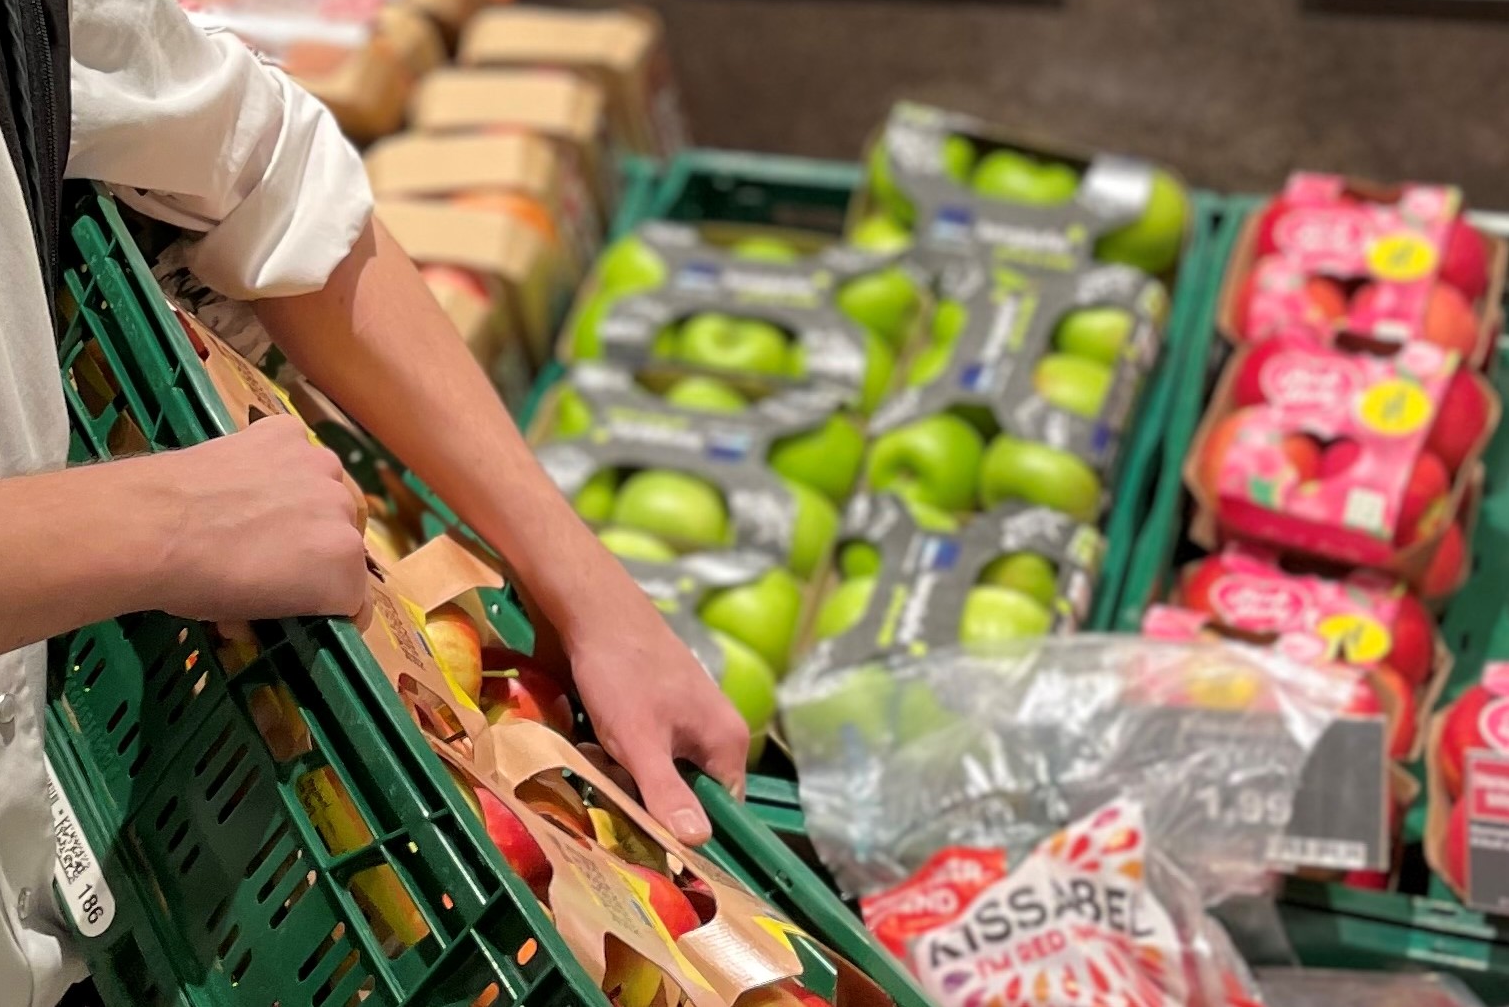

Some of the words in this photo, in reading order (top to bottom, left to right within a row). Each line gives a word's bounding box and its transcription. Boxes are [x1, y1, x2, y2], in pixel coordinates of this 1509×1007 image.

[77, 883, 104, 925] 186
[929, 878, 1154, 968] KISSABEL
[1017, 929, 1066, 962] RED
